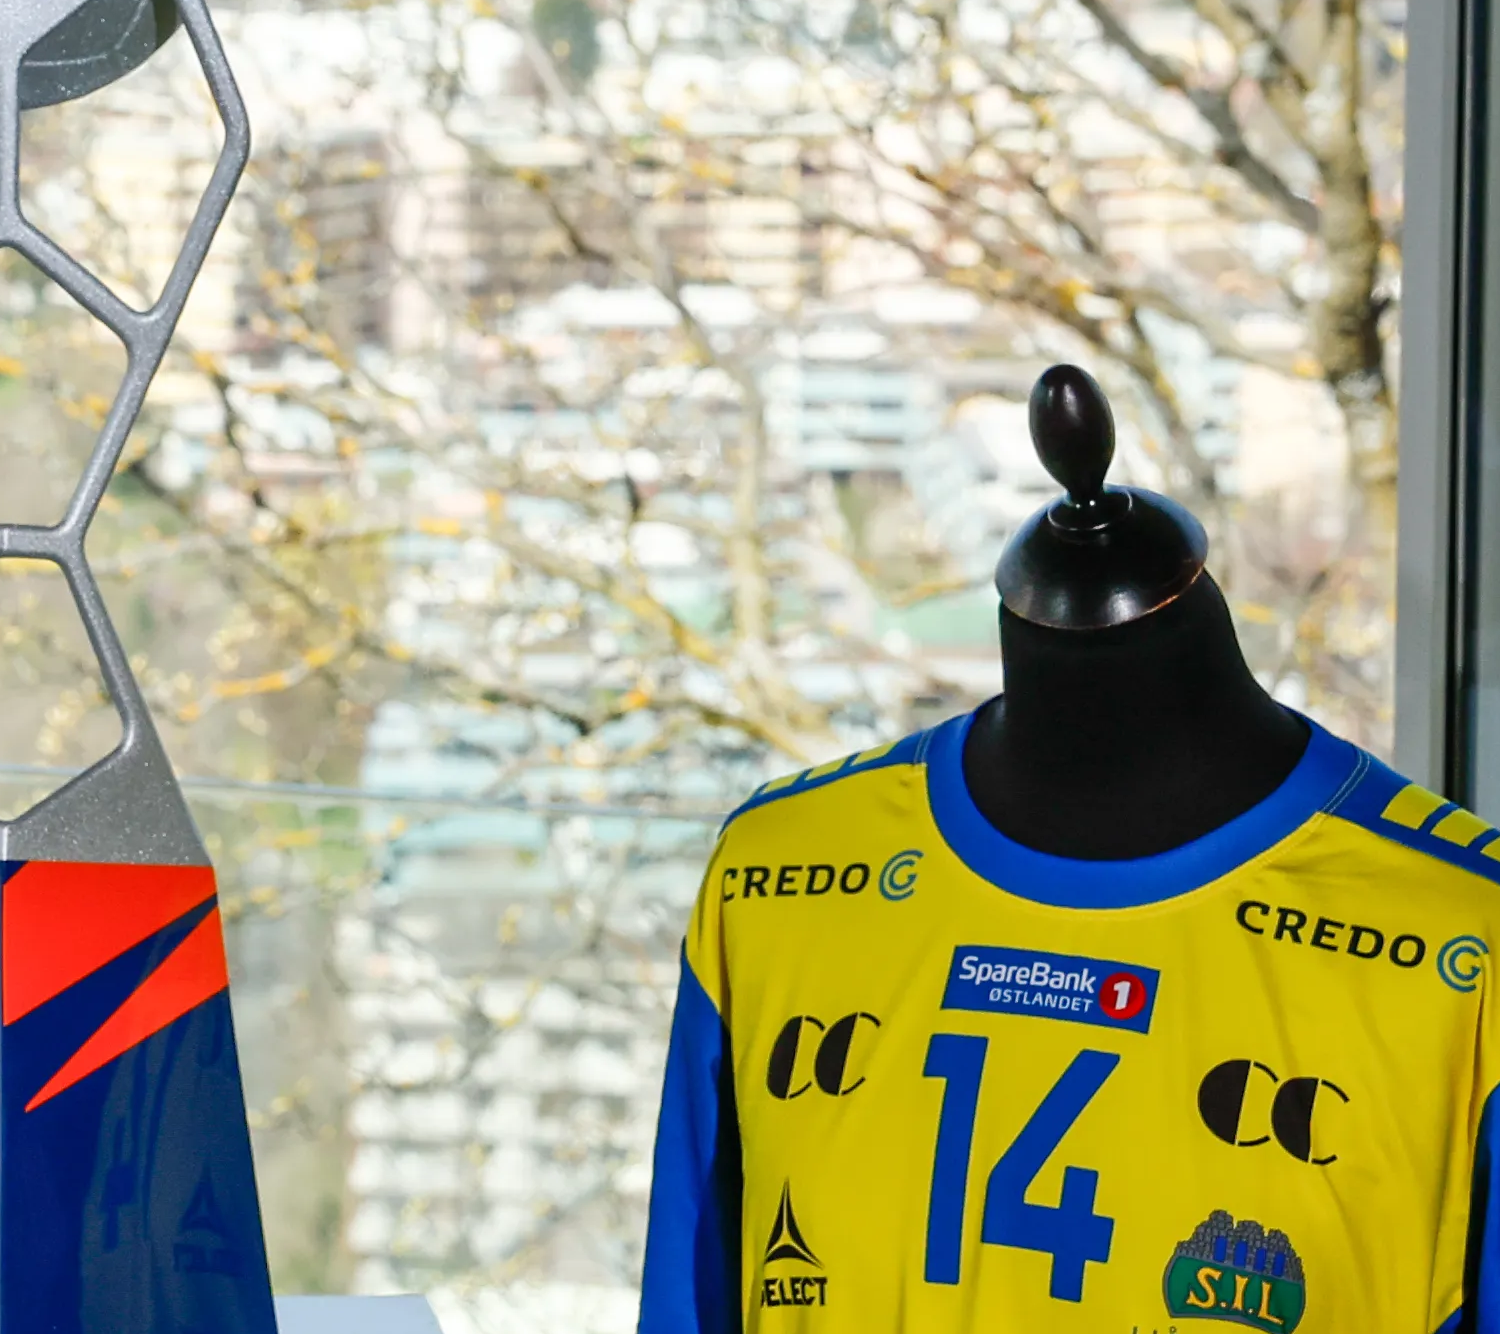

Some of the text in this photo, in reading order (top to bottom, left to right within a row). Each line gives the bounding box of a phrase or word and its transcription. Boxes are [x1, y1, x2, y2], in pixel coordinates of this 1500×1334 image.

[1235, 900, 1426, 968] CREDO
[958, 955, 1096, 994] SpareBank
[988, 987, 1094, 1013] ØSTLANDET
[923, 1033, 1121, 1303] 14
[761, 1276, 827, 1307] ELECT
